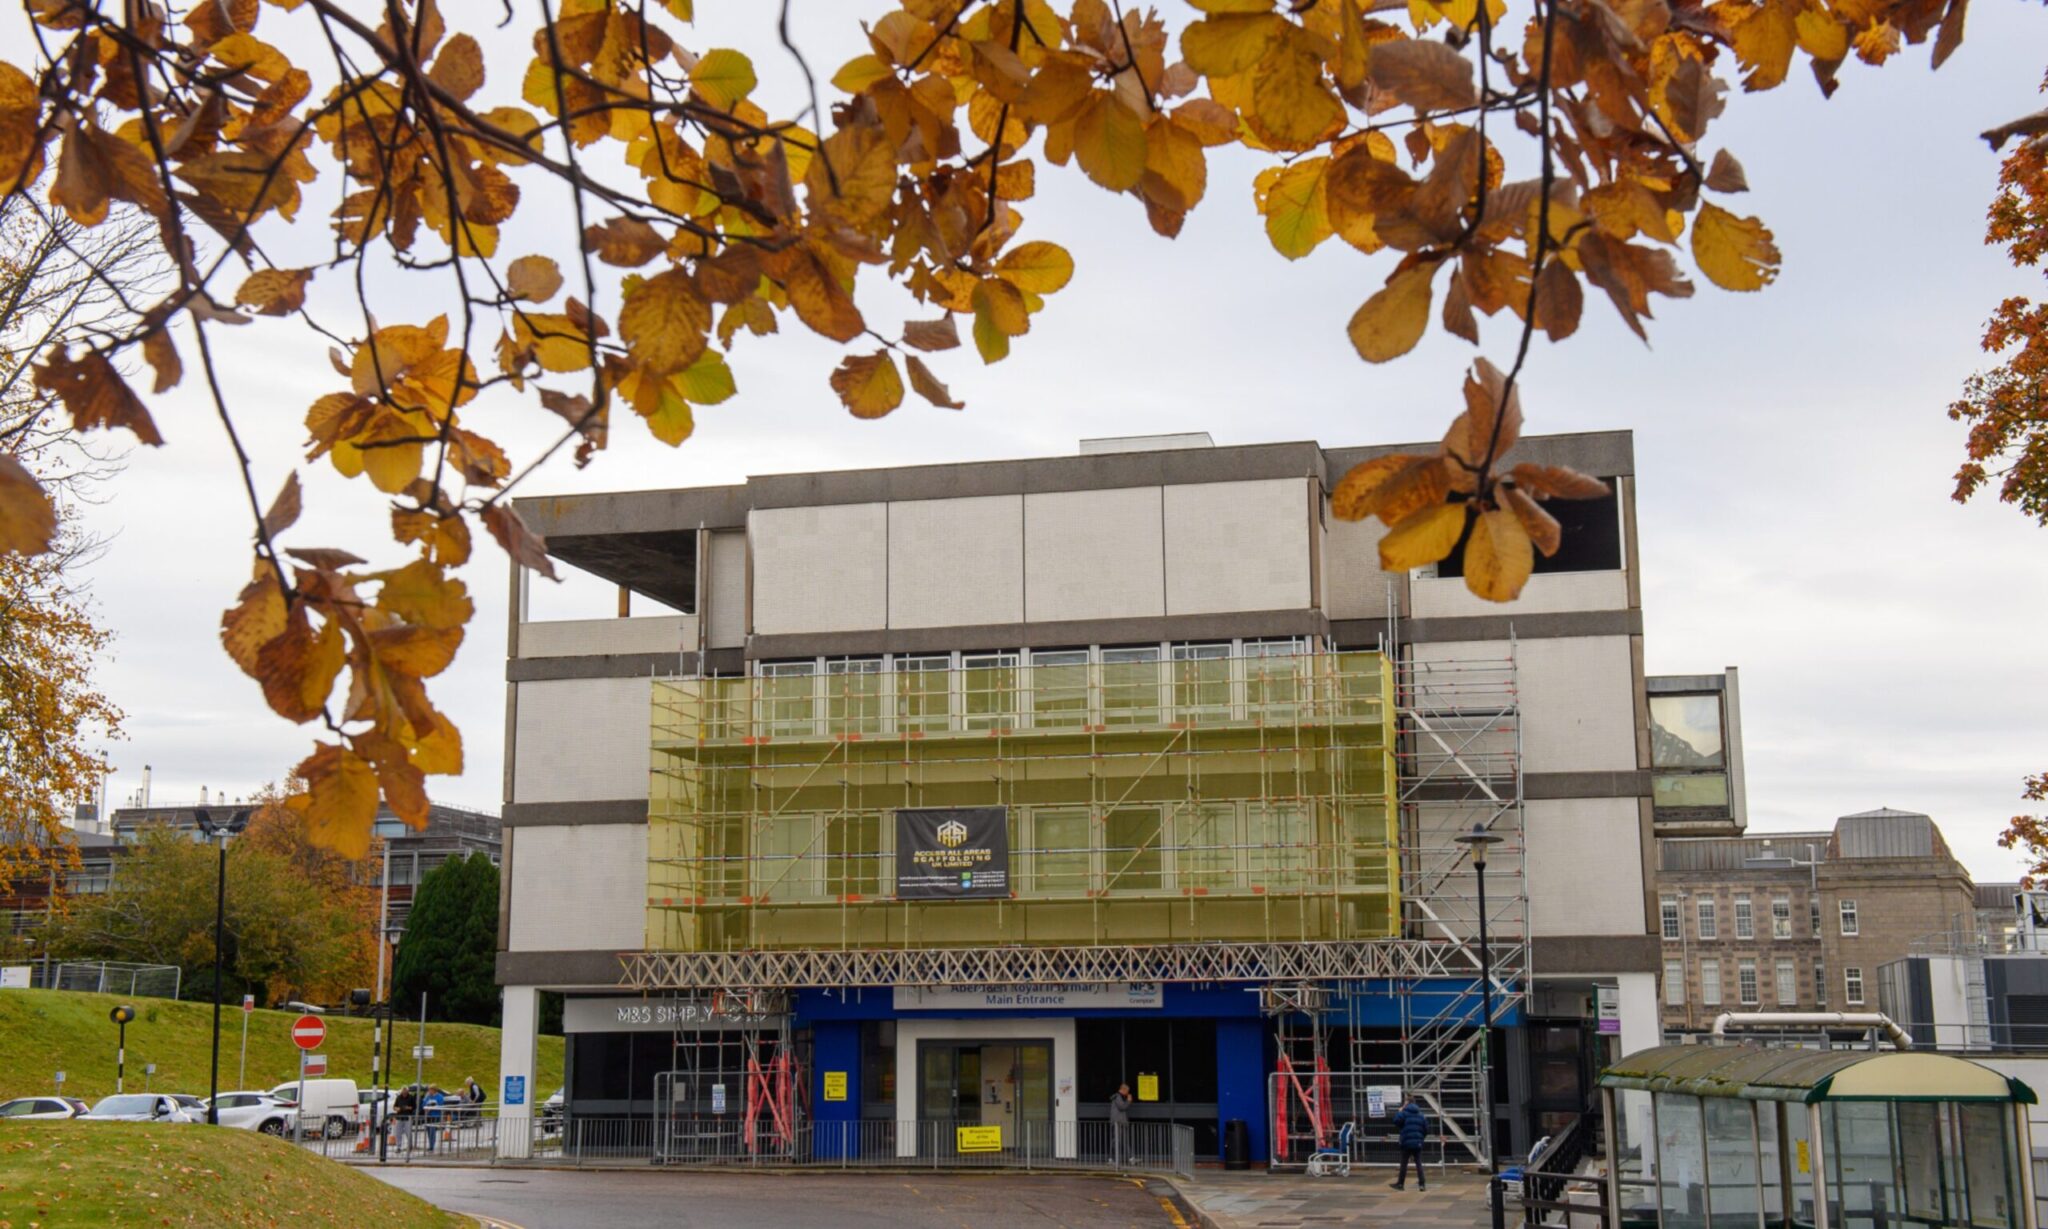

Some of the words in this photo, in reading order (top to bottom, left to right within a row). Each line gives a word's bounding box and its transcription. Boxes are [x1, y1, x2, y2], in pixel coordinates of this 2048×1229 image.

[986, 995, 1013, 1005] Main
[1016, 994, 1065, 1005] Entrance
[617, 1006, 651, 1024] M&S
